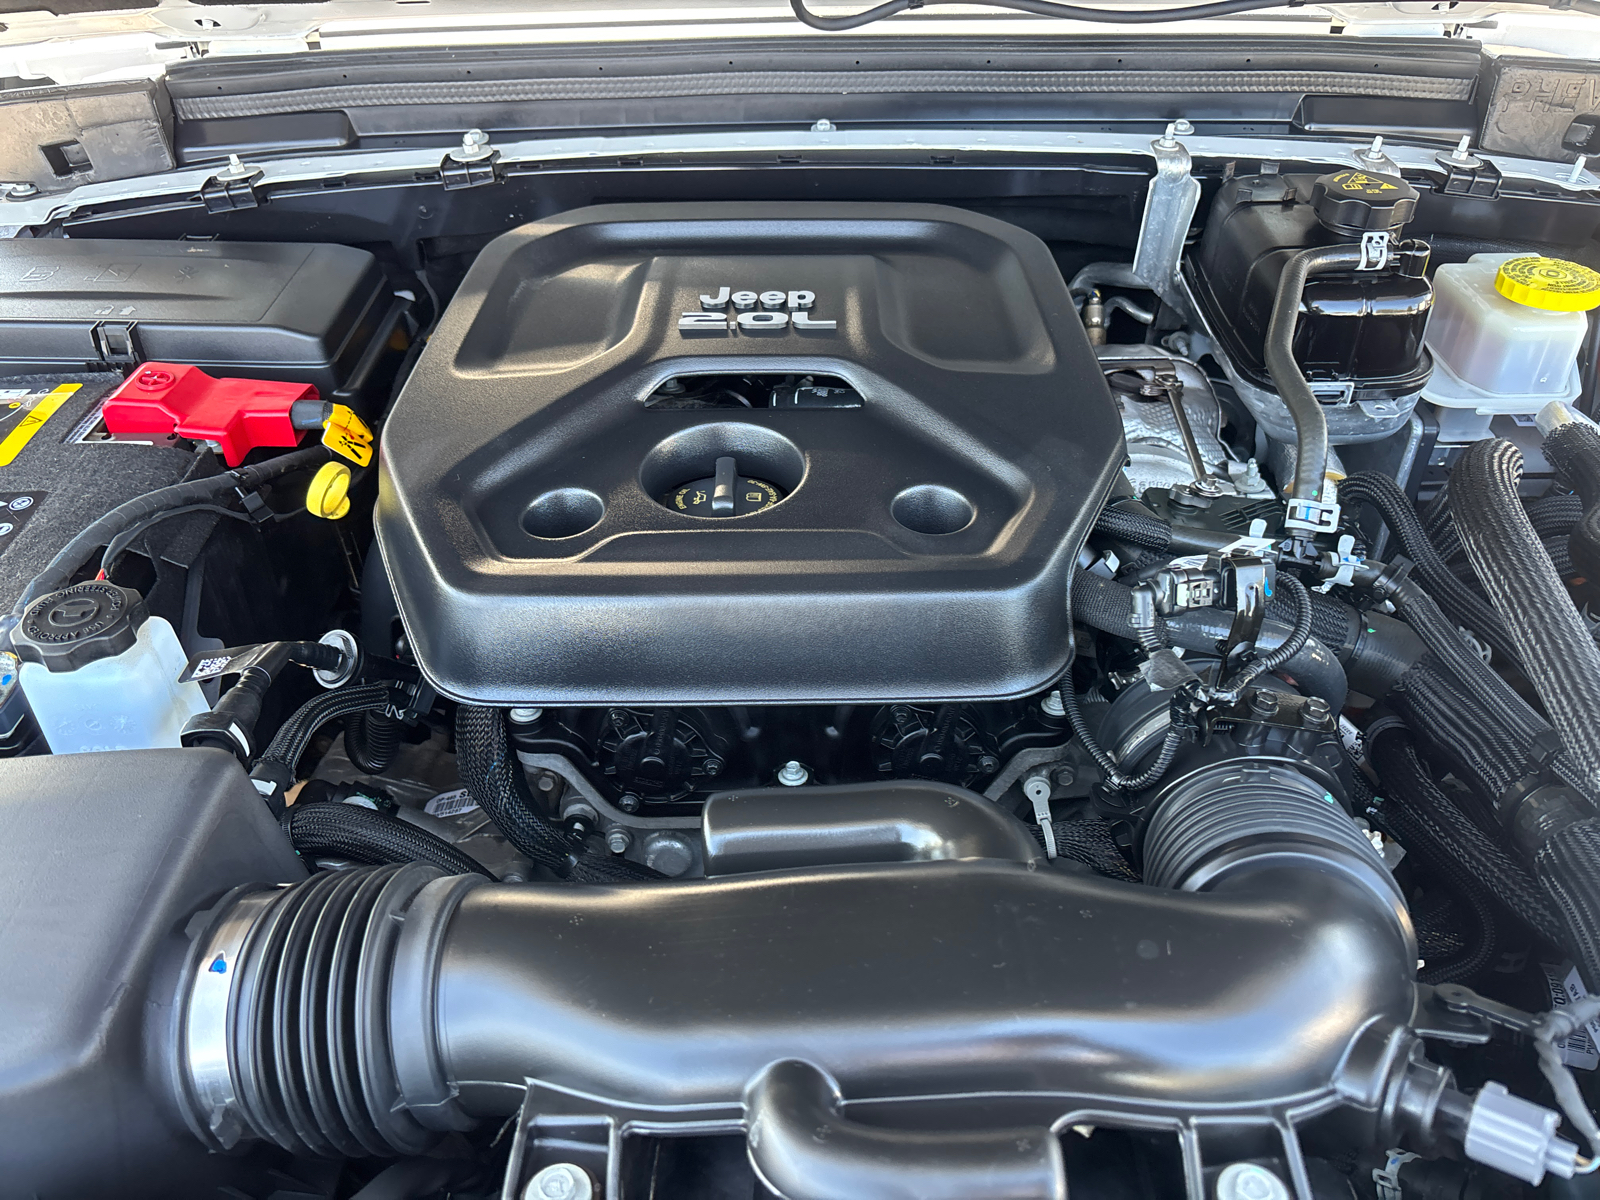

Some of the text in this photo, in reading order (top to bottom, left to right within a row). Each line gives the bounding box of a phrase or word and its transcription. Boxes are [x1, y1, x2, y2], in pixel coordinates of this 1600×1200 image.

[700, 286, 816, 312] Jeep
[678, 311, 837, 330] 2.0L
[55, 585, 109, 598] STEERING
[29, 596, 54, 616] FLUID
[27, 620, 104, 641] USE APPROVED
